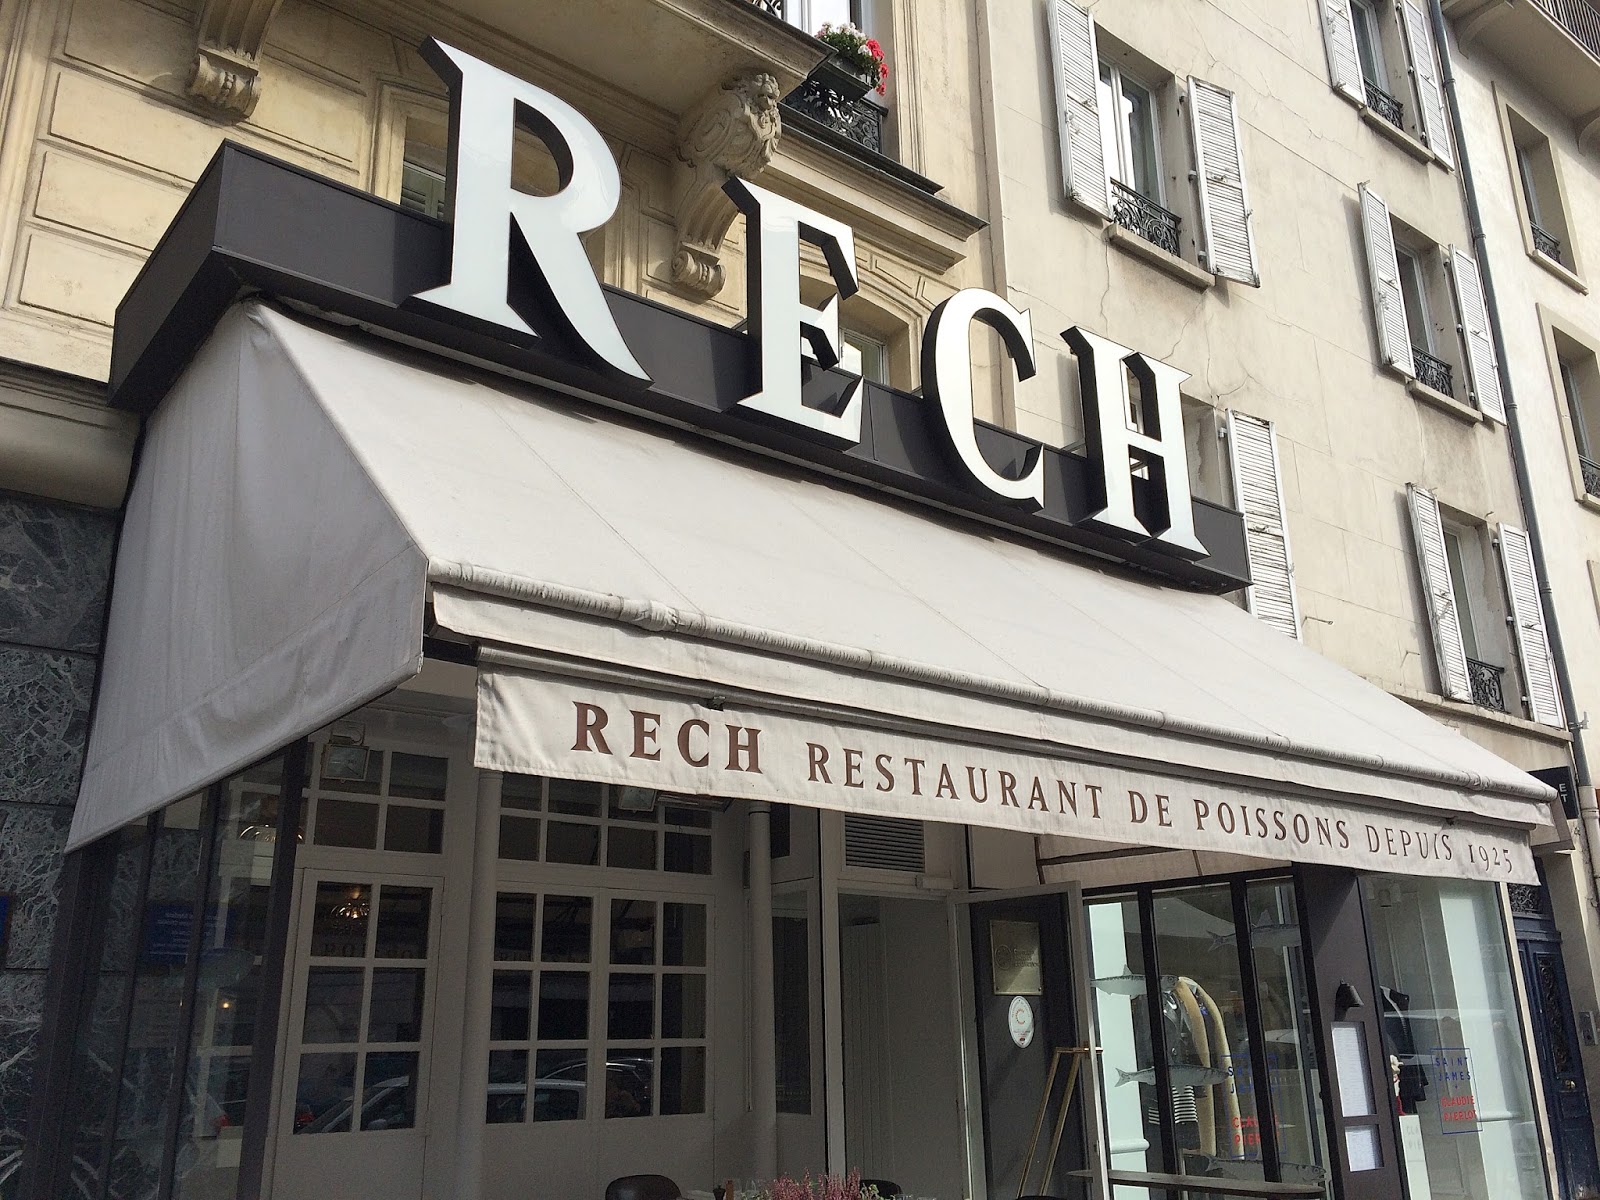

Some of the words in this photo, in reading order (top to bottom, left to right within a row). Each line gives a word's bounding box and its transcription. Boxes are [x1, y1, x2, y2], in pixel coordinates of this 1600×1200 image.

[412, 36, 1211, 560] RECH
[570, 701, 763, 774] RECH
[806, 742, 1103, 819] RESTAURANT
[1128, 790, 1173, 827] DE
[1194, 799, 1350, 849] POISSONS
[1365, 823, 1453, 861] DEPUIS
[1469, 844, 1513, 873] 1925
[1435, 1057, 1468, 1067] SAINT
[1438, 1071, 1471, 1081] JAMES
[1441, 1096, 1475, 1107] CLAUDIE
